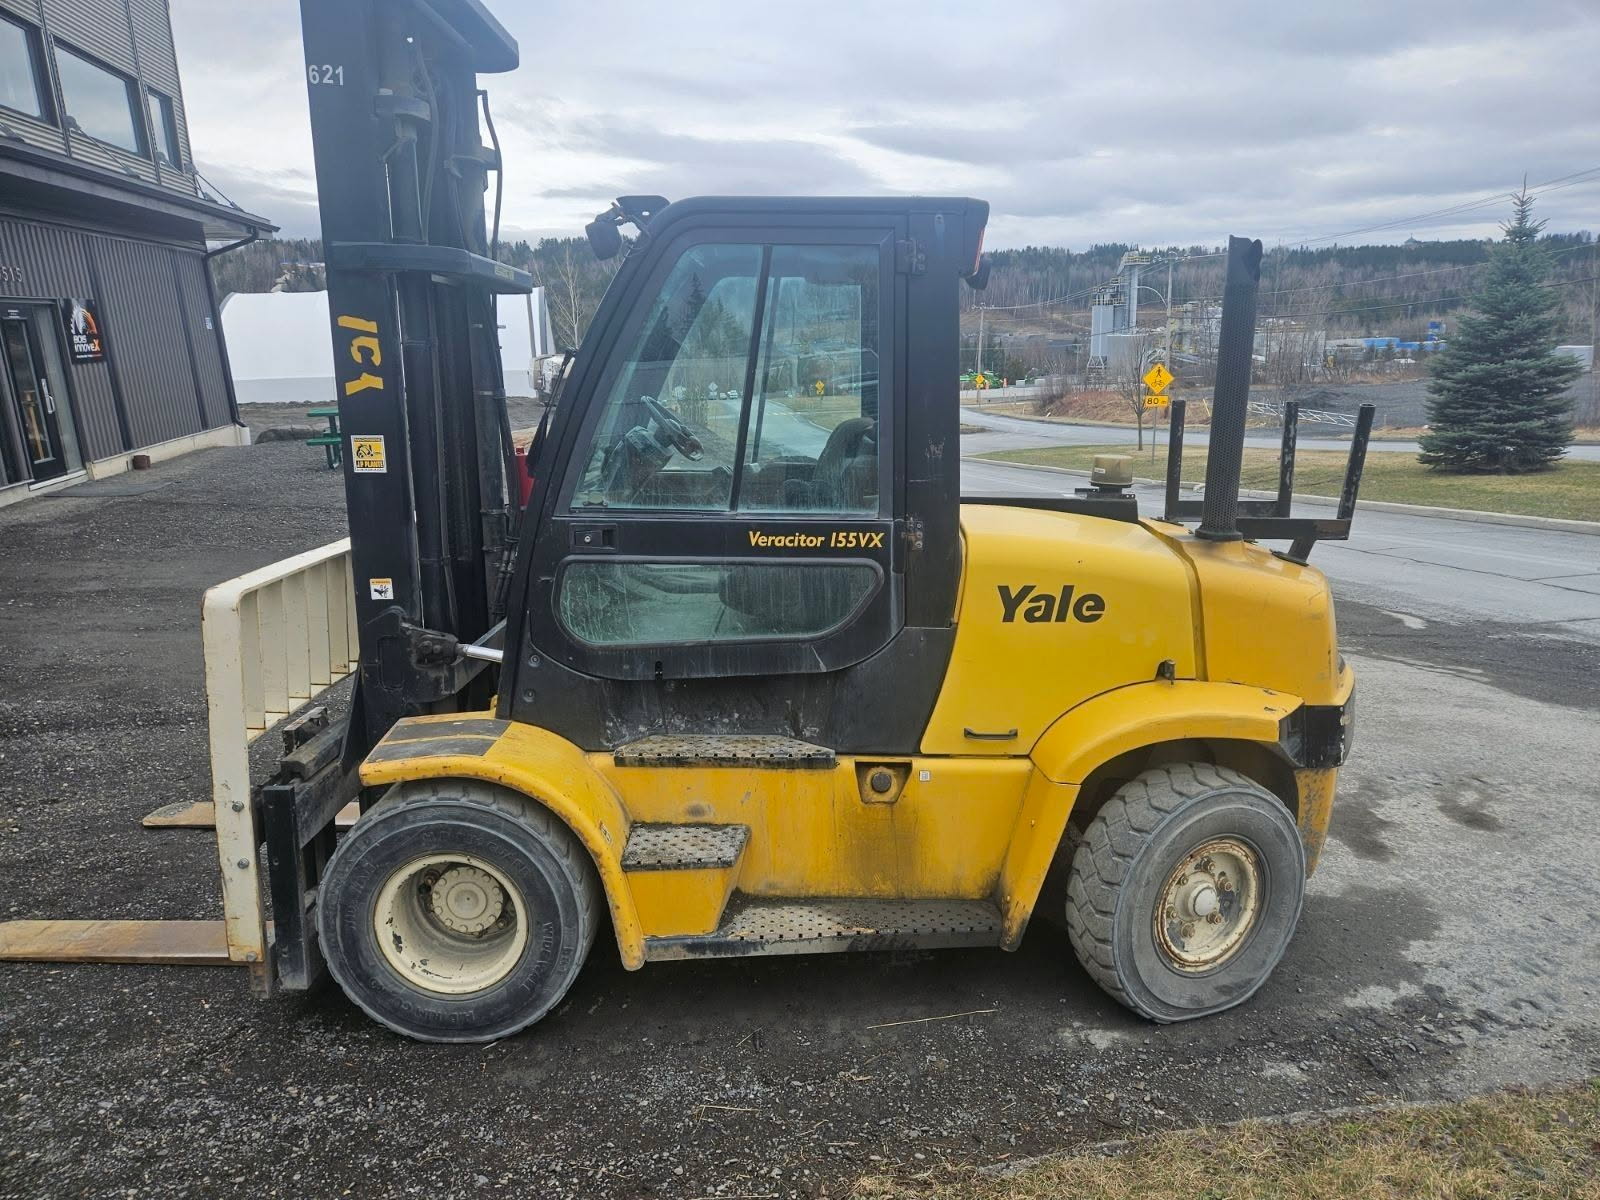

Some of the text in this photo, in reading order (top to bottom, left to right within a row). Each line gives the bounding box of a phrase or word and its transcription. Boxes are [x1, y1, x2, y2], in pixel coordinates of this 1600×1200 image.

[308, 64, 344, 86] 621
[0, 265, 22, 281] 515
[73, 334, 87, 344] BOIS
[748, 530, 884, 548] Veracitor 155VX
[997, 584, 1106, 624] Yale
